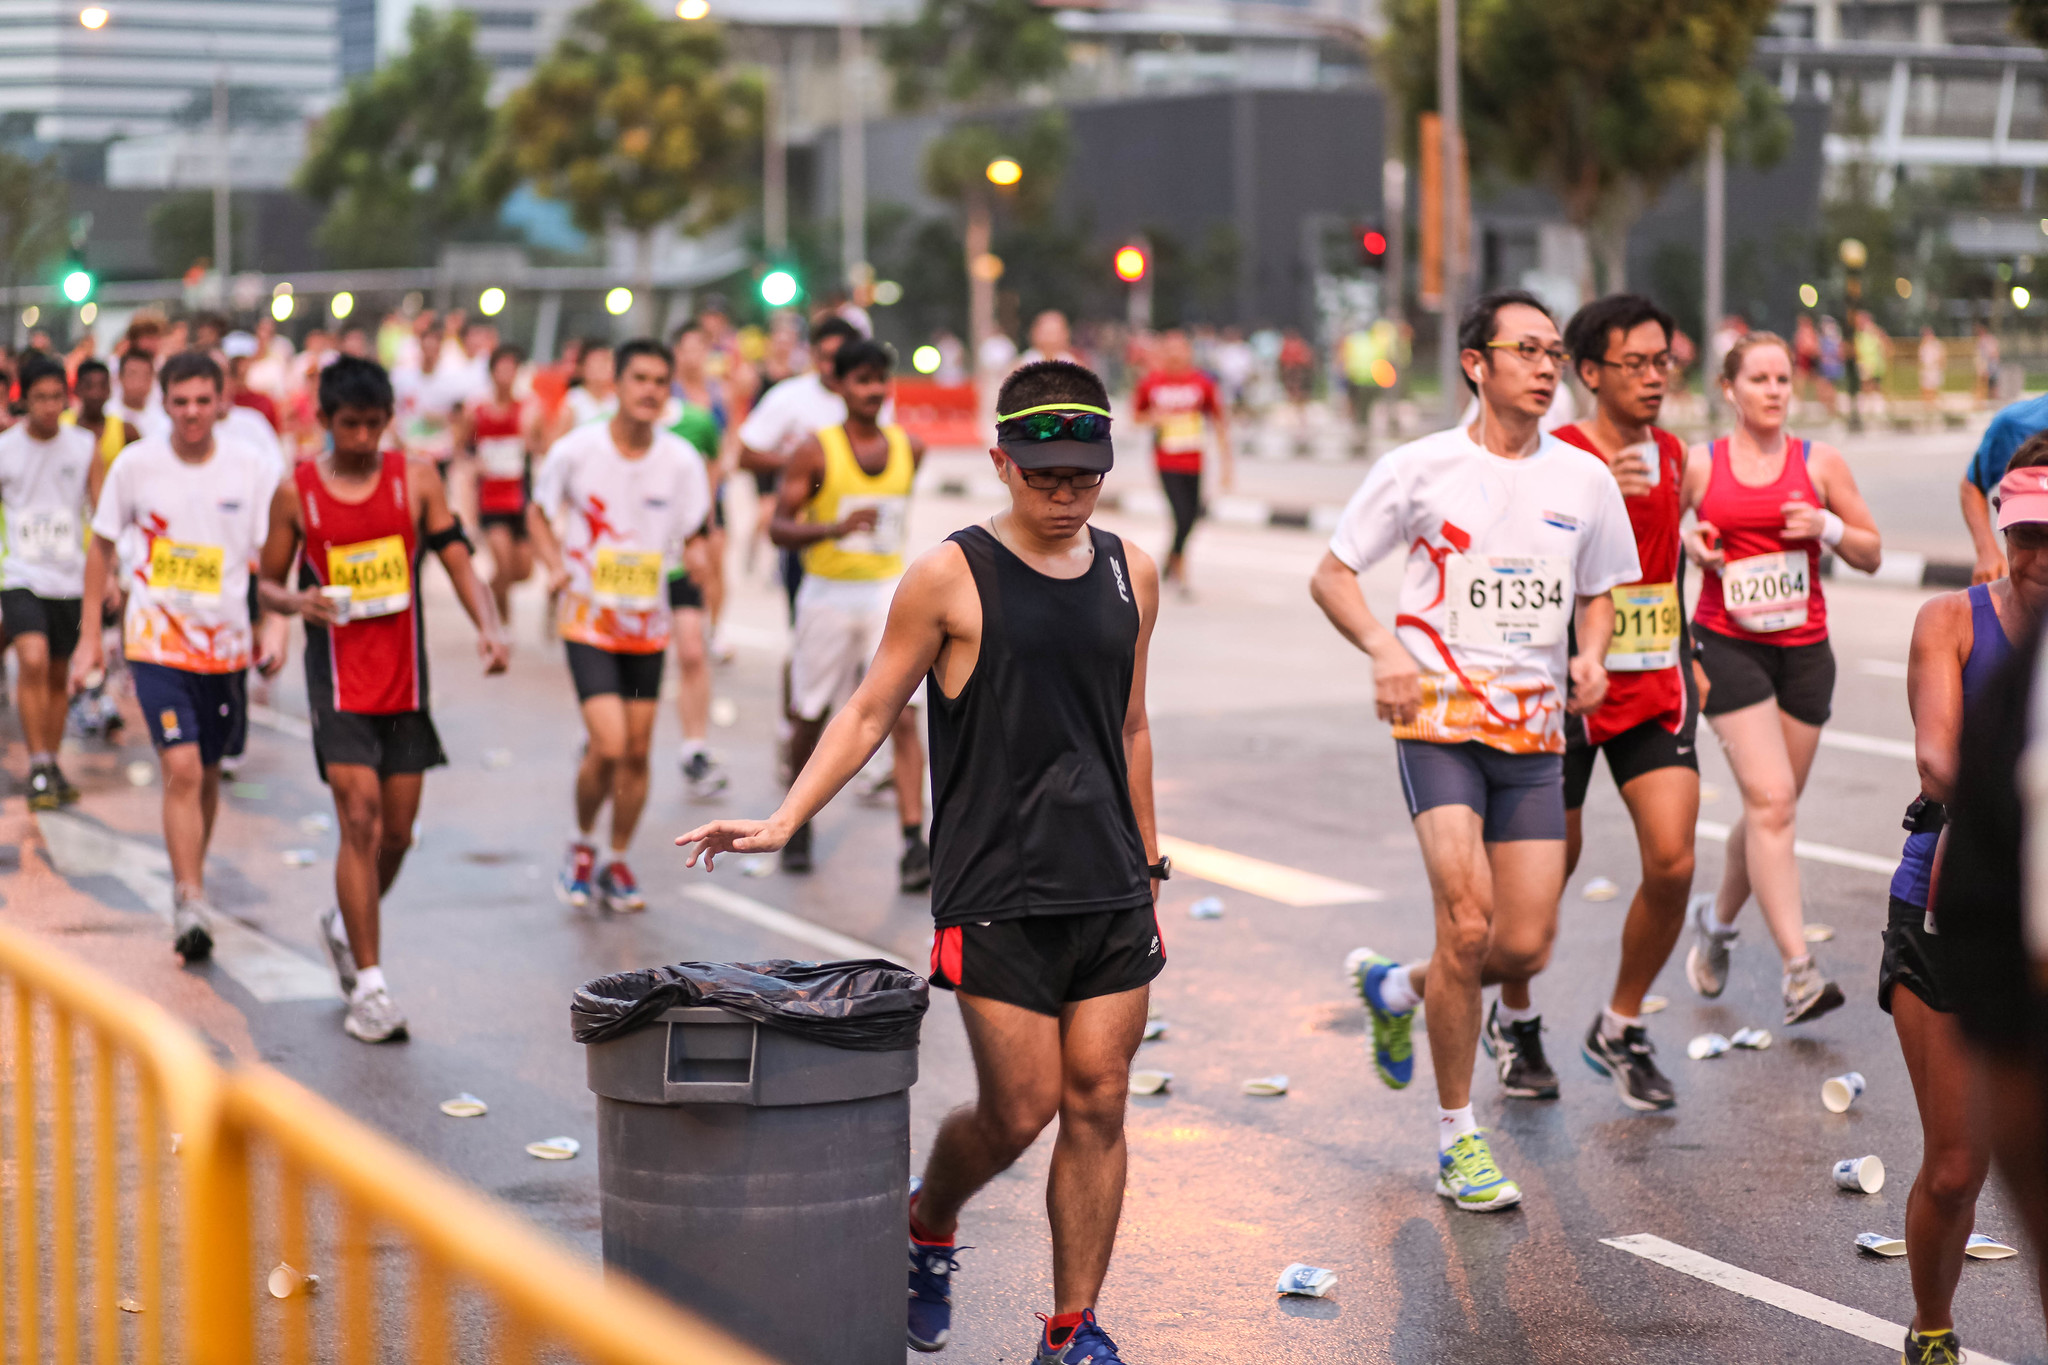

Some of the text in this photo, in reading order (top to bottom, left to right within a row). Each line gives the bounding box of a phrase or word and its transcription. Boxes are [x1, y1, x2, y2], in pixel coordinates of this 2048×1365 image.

[1110, 556, 1129, 603] 2XU
[1469, 578, 1564, 609] 61334
[1731, 571, 1803, 605] 82064
